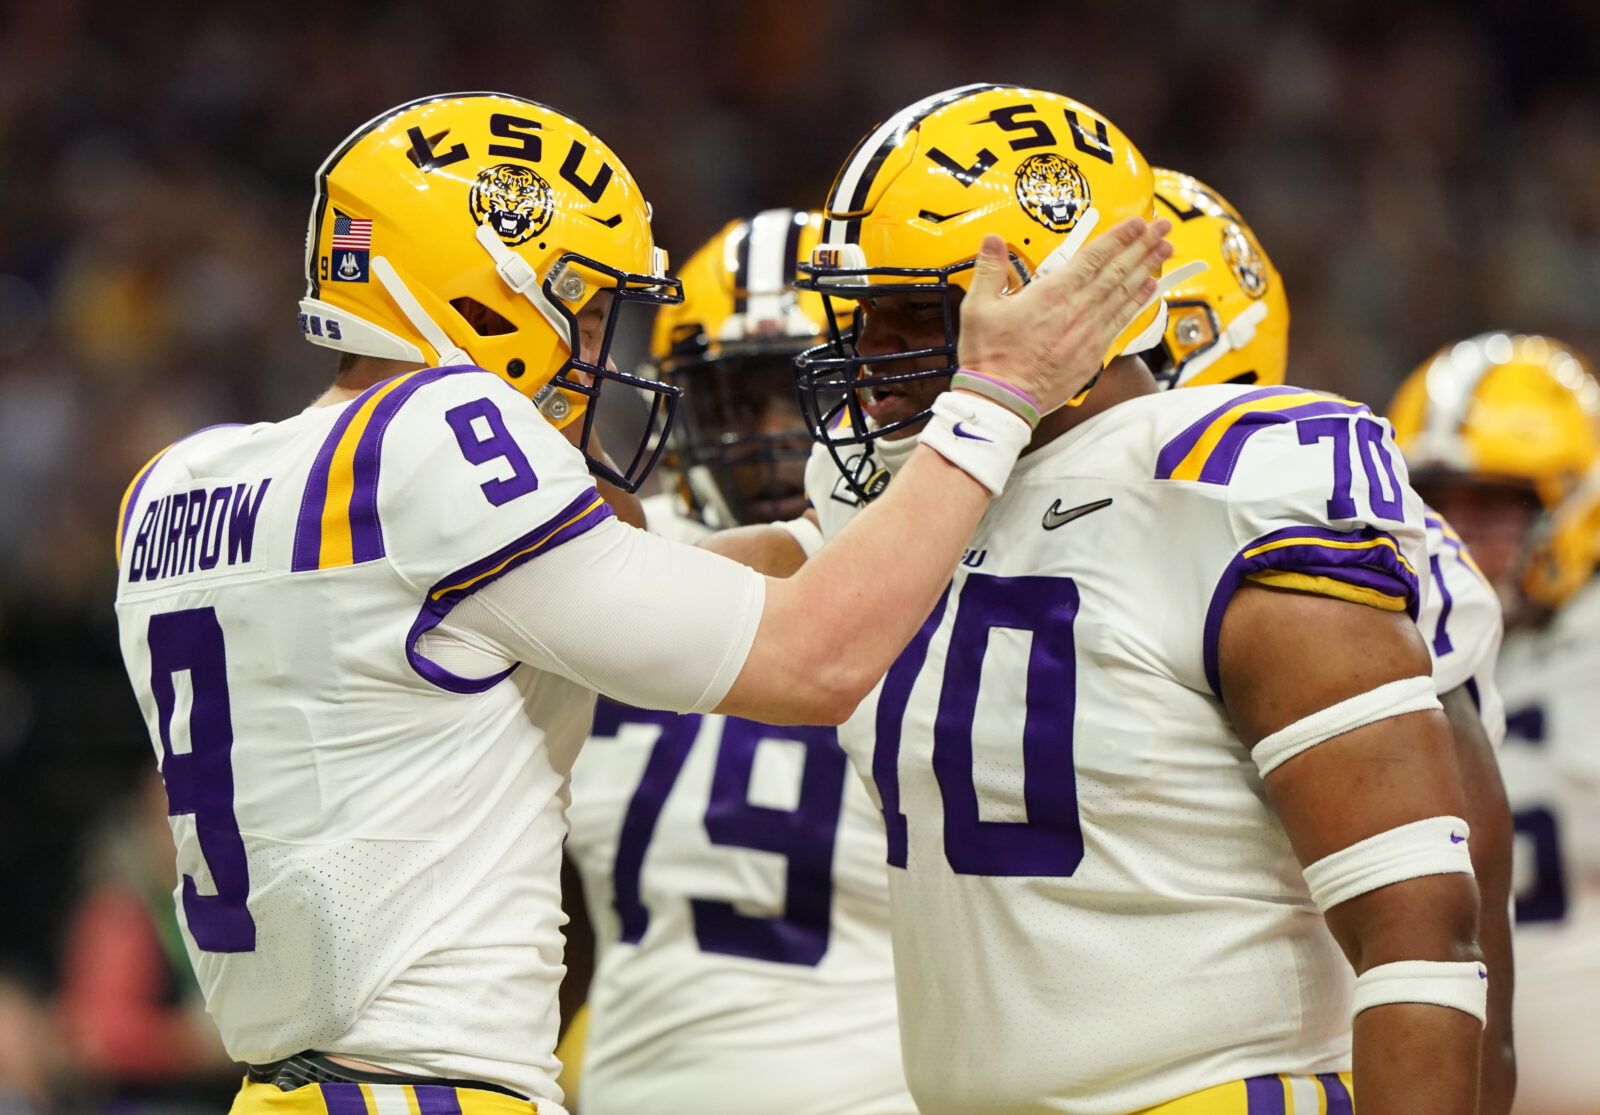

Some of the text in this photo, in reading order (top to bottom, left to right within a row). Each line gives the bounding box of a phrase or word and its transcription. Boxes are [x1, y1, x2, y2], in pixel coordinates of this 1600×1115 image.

[406, 113, 614, 204] LSU
[926, 104, 1114, 187] LSU
[321, 257, 328, 281] 9
[813, 250, 839, 268] LSU
[445, 397, 538, 507] 9
[1296, 416, 1405, 523] 70
[128, 478, 271, 583] BURROW
[147, 607, 256, 954] 9
[591, 695, 848, 967] 79
